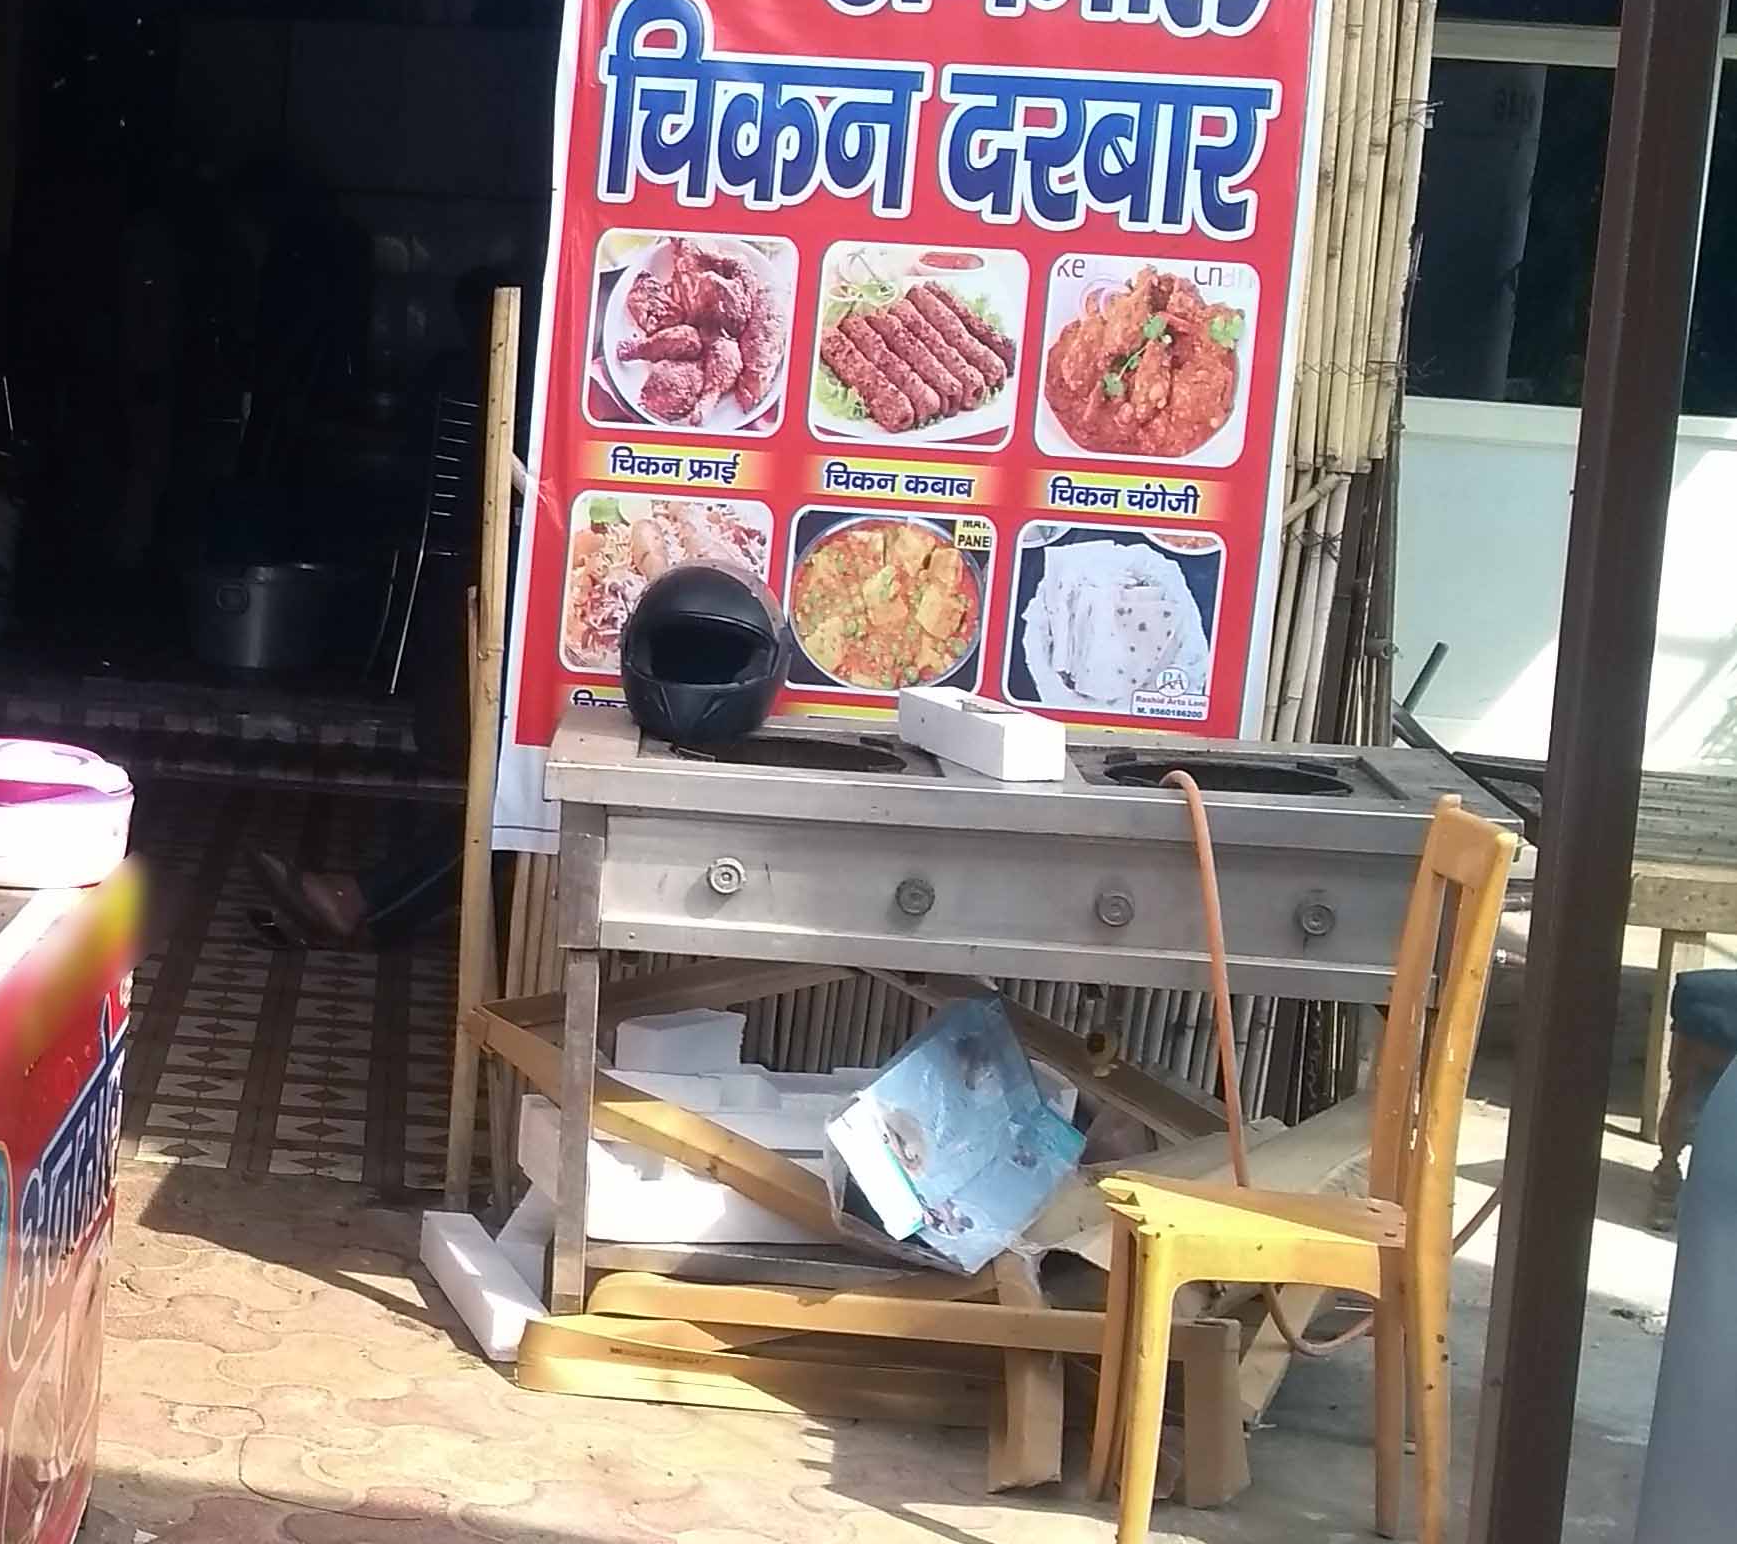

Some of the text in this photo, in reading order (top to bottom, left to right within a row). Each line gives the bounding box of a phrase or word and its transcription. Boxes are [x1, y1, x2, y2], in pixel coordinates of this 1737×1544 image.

[939, 64, 1281, 240] दरबार
[610, 446, 741, 486] चिकन फ्राई
[823, 463, 974, 499] चिकन कबाब
[1050, 477, 1201, 515] चिकन चंगेजी
